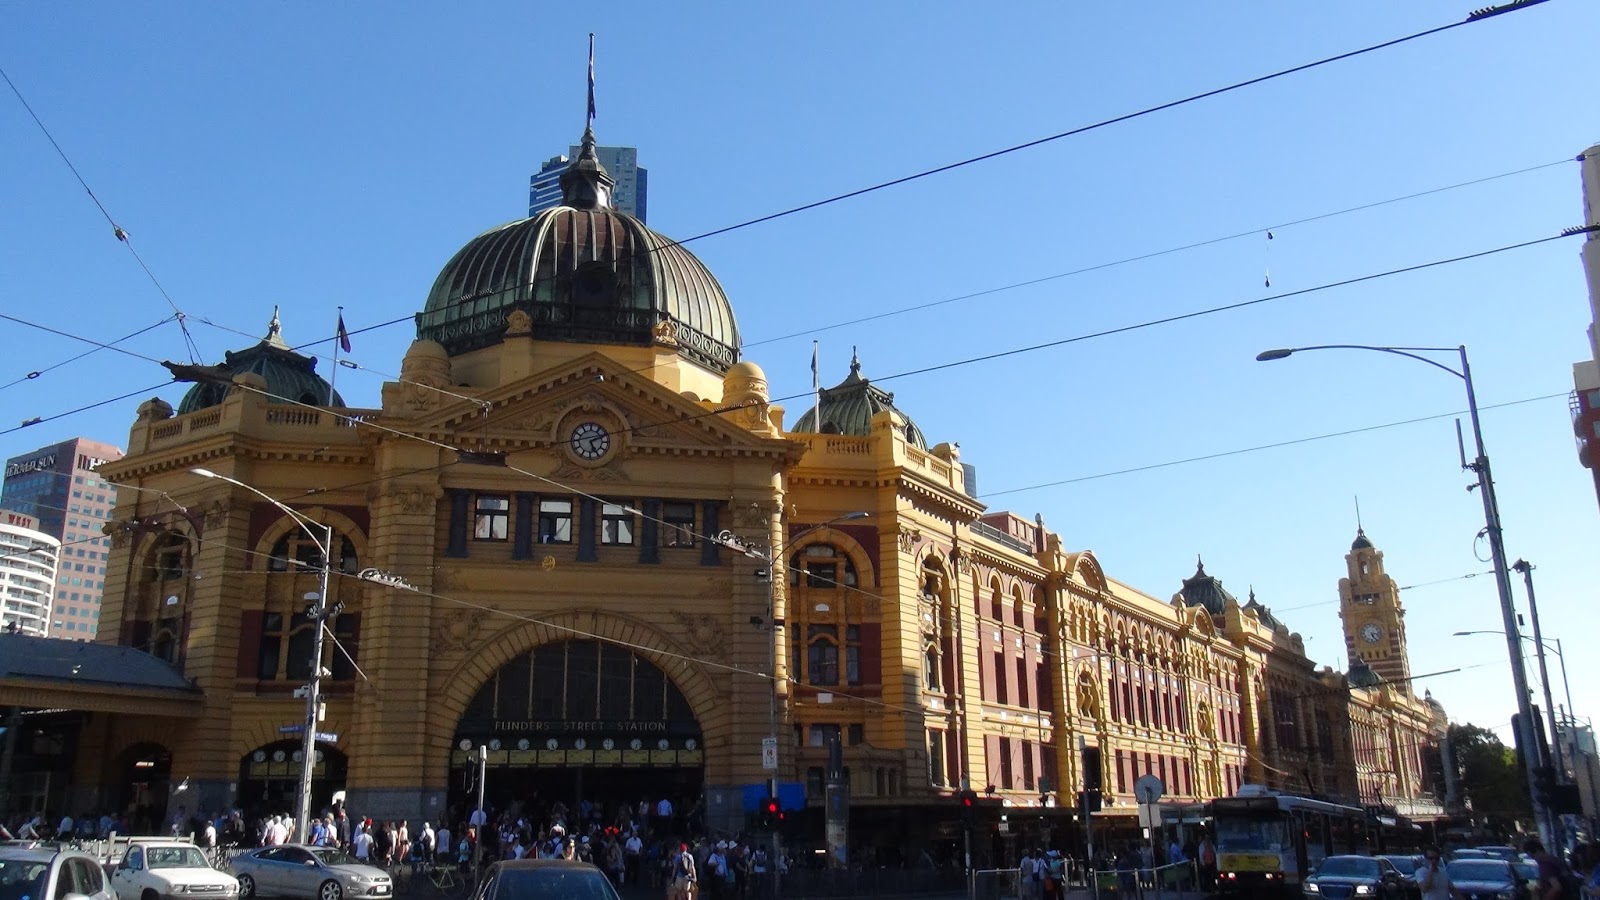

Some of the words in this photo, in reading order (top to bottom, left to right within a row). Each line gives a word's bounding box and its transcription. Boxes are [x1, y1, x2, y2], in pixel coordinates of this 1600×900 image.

[38, 455, 56, 468] SUN
[495, 721, 549, 731] FLINDERS
[563, 721, 605, 731] STREET
[617, 721, 667, 731] STATION
